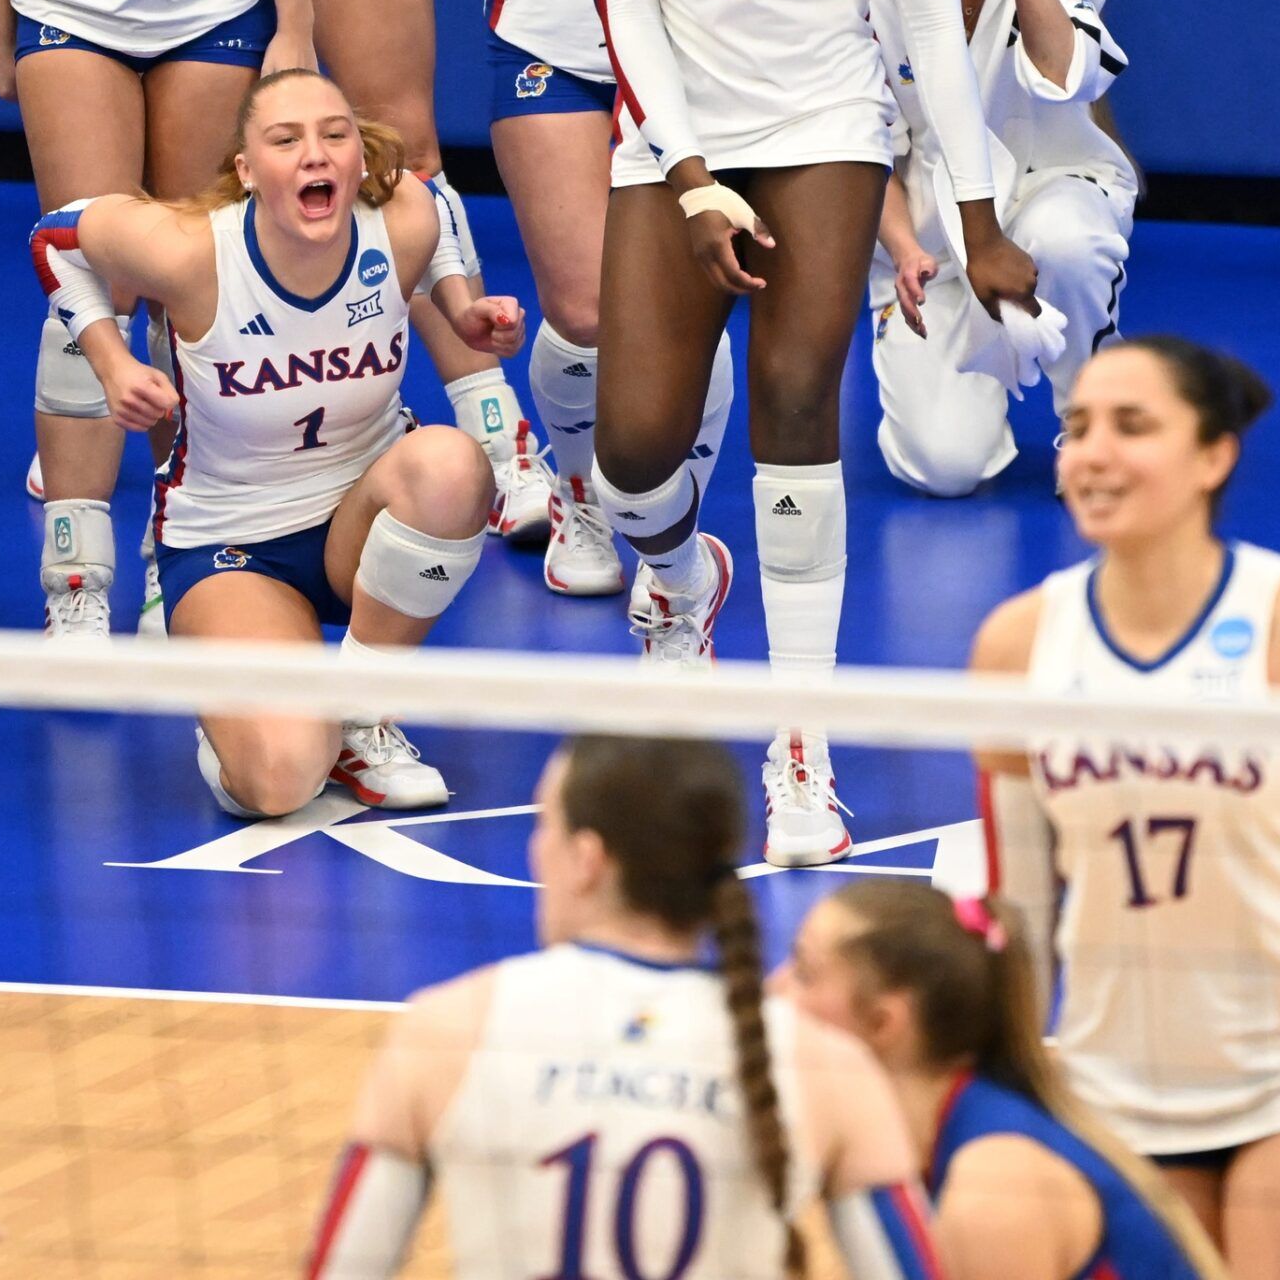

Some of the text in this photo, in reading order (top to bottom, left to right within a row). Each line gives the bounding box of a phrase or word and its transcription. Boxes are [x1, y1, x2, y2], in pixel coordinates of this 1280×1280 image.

[362, 262, 389, 282] NCAA
[213, 332, 403, 397] KANSAS
[294, 407, 328, 451] 1
[772, 507, 803, 516] adidas
[419, 570, 450, 582] adidas
[1110, 816, 1198, 908] 17
[535, 1127, 710, 1280] 10
